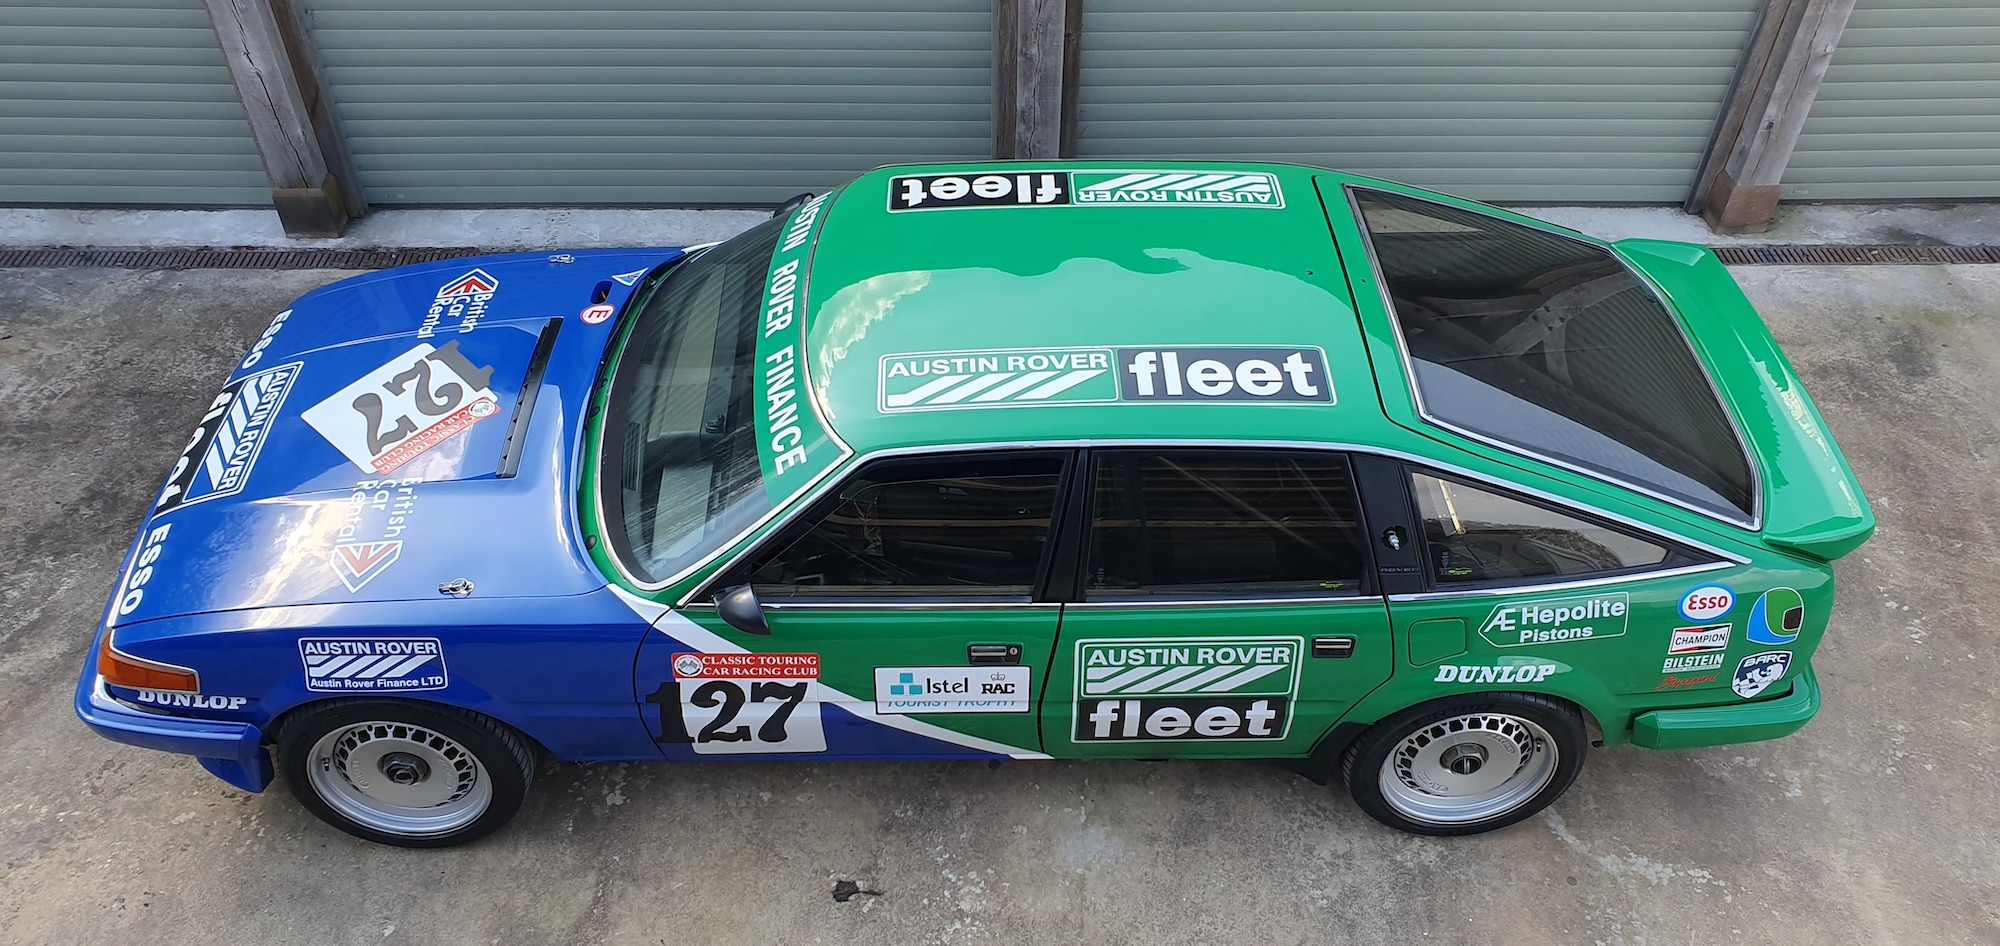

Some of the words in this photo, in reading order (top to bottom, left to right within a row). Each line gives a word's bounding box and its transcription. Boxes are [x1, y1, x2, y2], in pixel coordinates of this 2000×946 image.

[901, 173, 1063, 207] fleet
[1079, 189, 1169, 203] ROVER
[1174, 190, 1271, 203] AUSTIN
[447, 296, 471, 317] Car
[765, 258, 799, 339] ROVER
[417, 297, 454, 338] Rental
[458, 293, 494, 334] British
[588, 309, 609, 320] E
[242, 309, 293, 370] ESSO
[888, 357, 999, 378] AUSTIN
[1007, 353, 1109, 372] ROVER
[1128, 351, 1319, 397] fleet
[247, 371, 290, 428] AUSTIN
[352, 339, 496, 457] 127
[766, 344, 808, 476] FINANCE
[432, 416, 475, 442] CLASSIC
[448, 409, 469, 425] CAR
[404, 424, 446, 449] RACING
[217, 428, 261, 491] ROVER
[374, 449, 404, 467] CLUB
[381, 442, 431, 473] TOURING
[371, 479, 398, 511] Car
[384, 477, 424, 538] British
[336, 480, 380, 543] Rental
[120, 523, 172, 616] ESSO
[1521, 599, 1626, 626] Hepolite
[1519, 626, 1593, 643] Pistons
[1675, 633, 1726, 646] CHAMPION
[305, 641, 371, 655] AUSTIN
[375, 641, 438, 654] ROVER
[701, 656, 756, 665] CLASSIC
[758, 656, 817, 665] TOURING
[1087, 648, 1190, 666] AUSTIN
[1197, 647, 1291, 665] ROVER
[1743, 653, 1788, 668] BARC
[702, 667, 730, 676] CAR
[733, 667, 781, 676] RACING
[783, 667, 818, 676] CLUB
[1434, 664, 1556, 683] DUNLOP
[1663, 654, 1725, 669] BILSTEIN
[310, 678, 342, 688] Austin
[344, 678, 375, 688] Rover
[377, 677, 419, 688] Finance
[421, 676, 444, 686] LTD
[926, 677, 968, 694] Istel
[981, 683, 1015, 694] RAC
[137, 690, 247, 710] DUNLOP
[645, 680, 809, 744] 127
[1089, 700, 1276, 738] fleet
